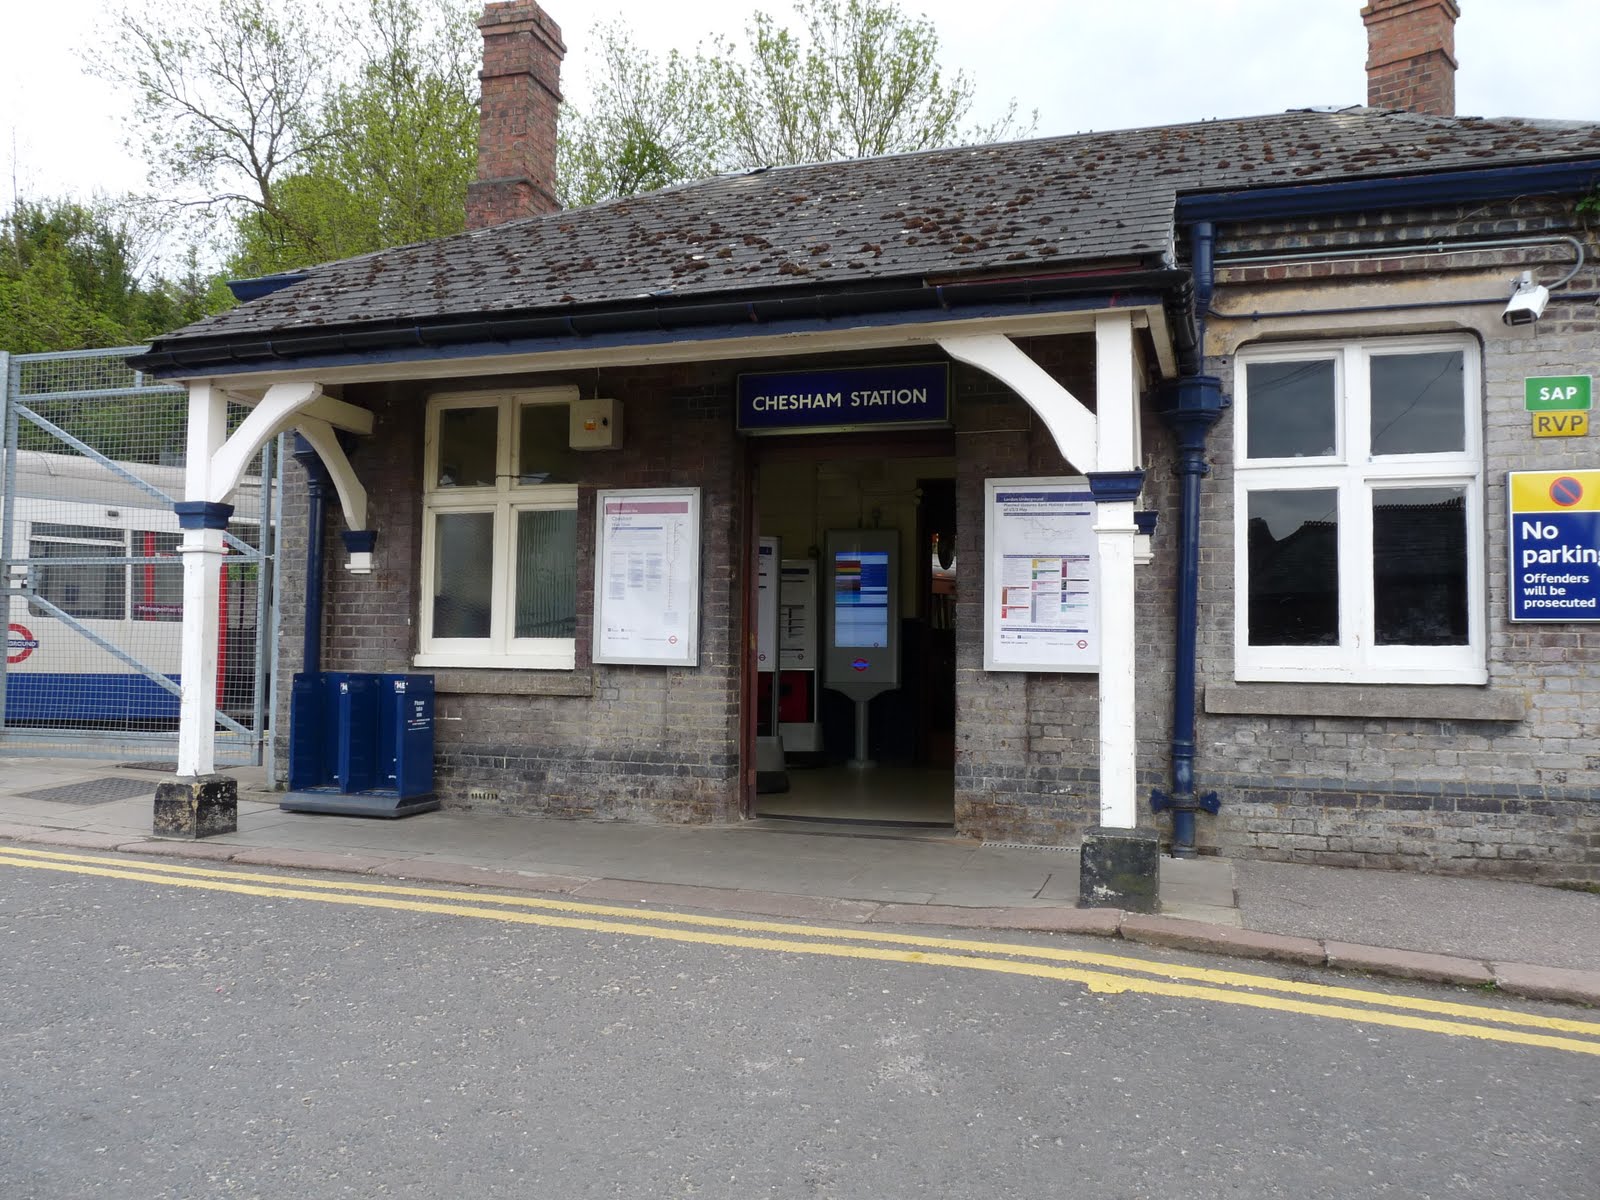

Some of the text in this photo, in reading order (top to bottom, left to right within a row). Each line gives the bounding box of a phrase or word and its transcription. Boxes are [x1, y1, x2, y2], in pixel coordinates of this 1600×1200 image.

[752, 388, 927, 411] CHESHAM STATION
[1539, 386, 1577, 400] SAP
[1538, 415, 1584, 432] RVP
[1522, 521, 1559, 540] No
[1523, 573, 1590, 584] Offenders
[1524, 585, 1566, 596] will be
[1524, 598, 1596, 610] prosecuted
